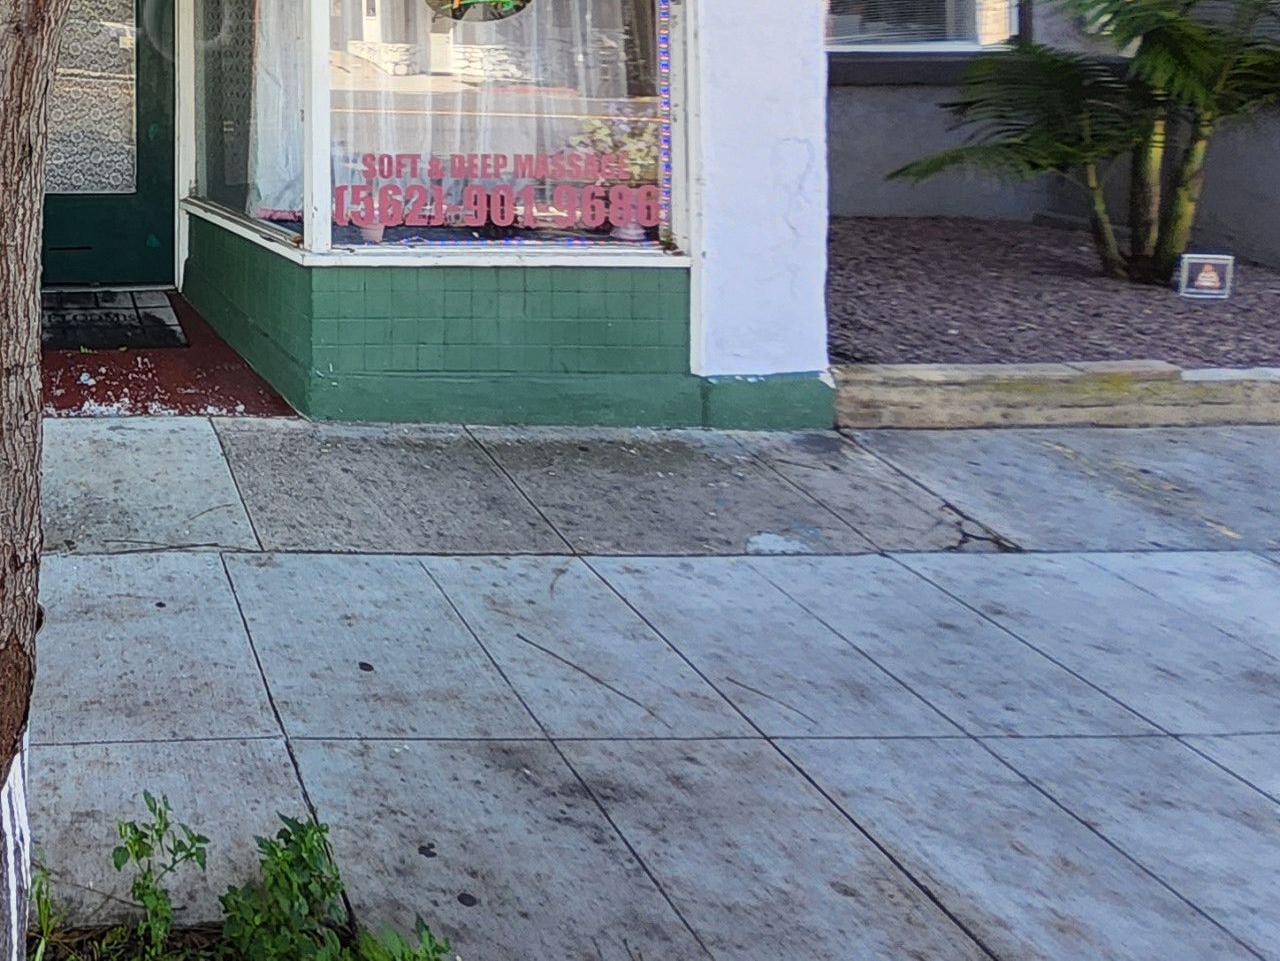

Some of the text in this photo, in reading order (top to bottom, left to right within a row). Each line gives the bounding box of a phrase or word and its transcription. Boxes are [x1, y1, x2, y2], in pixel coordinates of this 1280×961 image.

[361, 152, 630, 180] SOFT & DEEP MASSAGE
